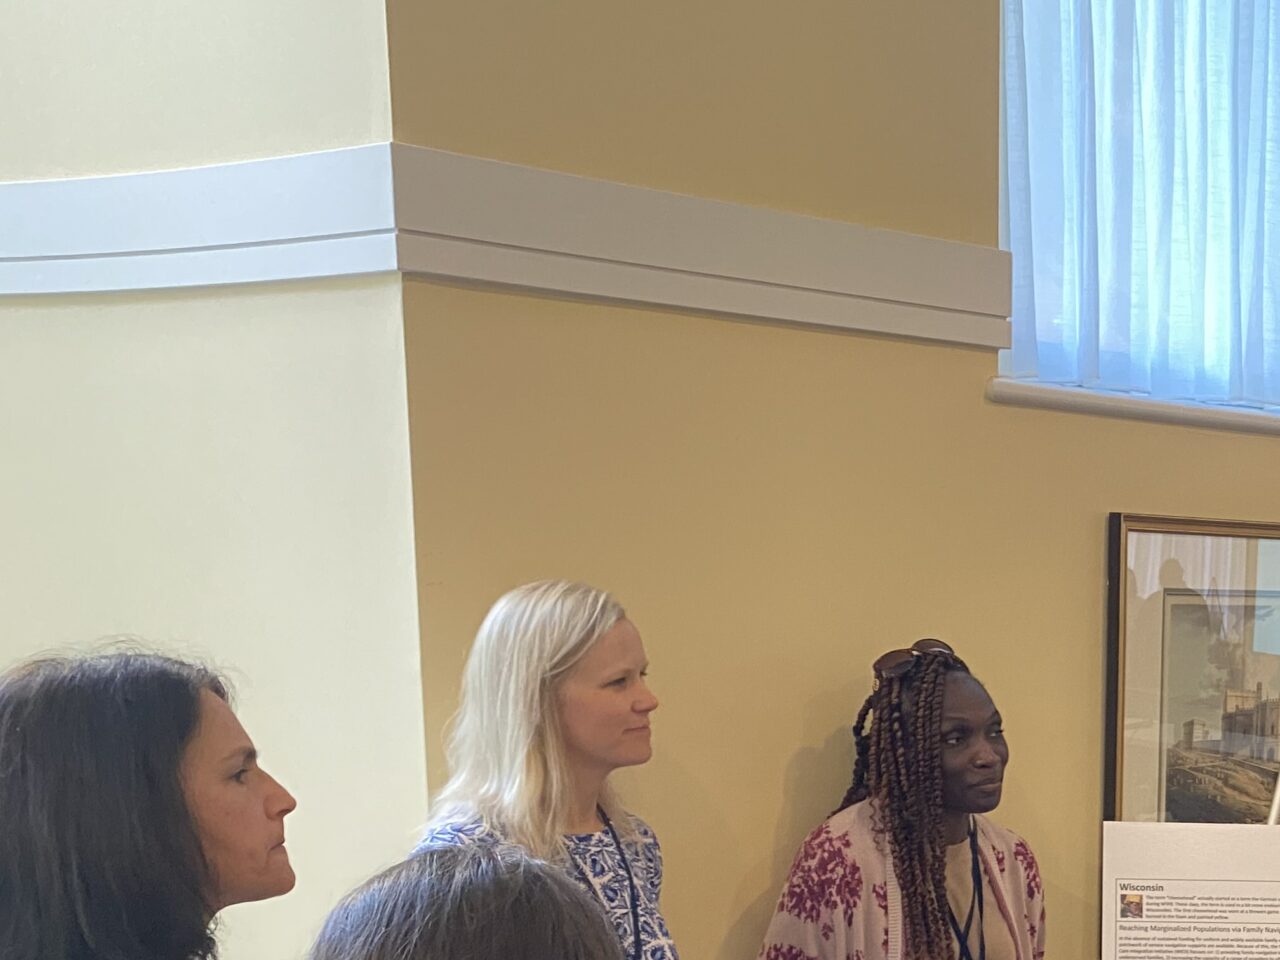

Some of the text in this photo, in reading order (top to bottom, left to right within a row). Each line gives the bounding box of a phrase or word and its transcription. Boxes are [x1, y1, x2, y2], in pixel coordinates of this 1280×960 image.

[1119, 883, 1164, 892] Wisconsin
[1119, 924, 1148, 932] Reaching
[1150, 925, 1192, 933] Marginalized
[1242, 926, 1263, 934] Family
